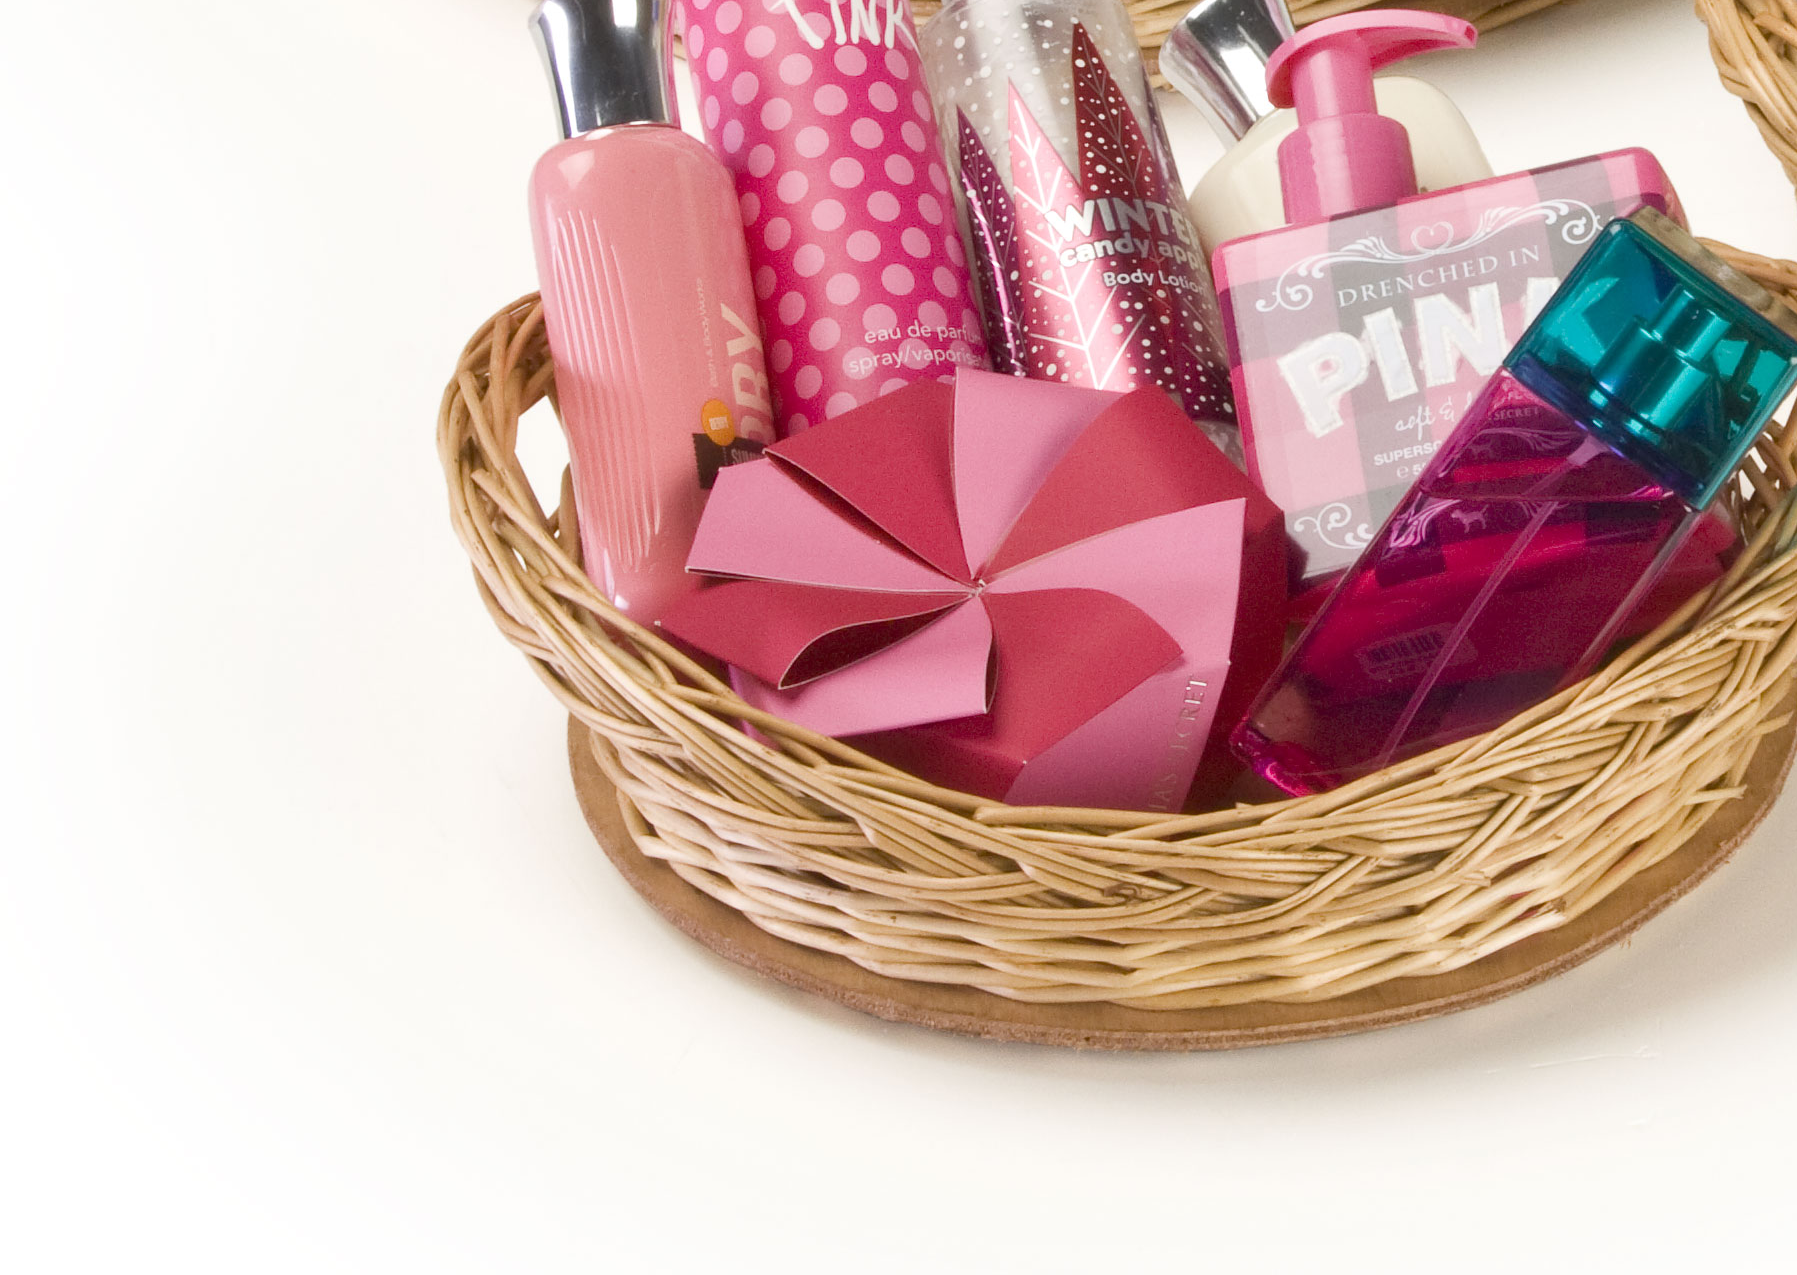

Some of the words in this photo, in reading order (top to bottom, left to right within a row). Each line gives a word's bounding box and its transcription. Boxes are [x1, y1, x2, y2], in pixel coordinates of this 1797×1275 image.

[1059, 231, 1149, 268] candy
[1102, 268, 1155, 287] Body
[1336, 255, 1499, 309] DRENCHED
[1508, 244, 1541, 268] IN
[864, 326, 901, 344] eau
[907, 318, 932, 339] de
[1394, 405, 1436, 441] soft
